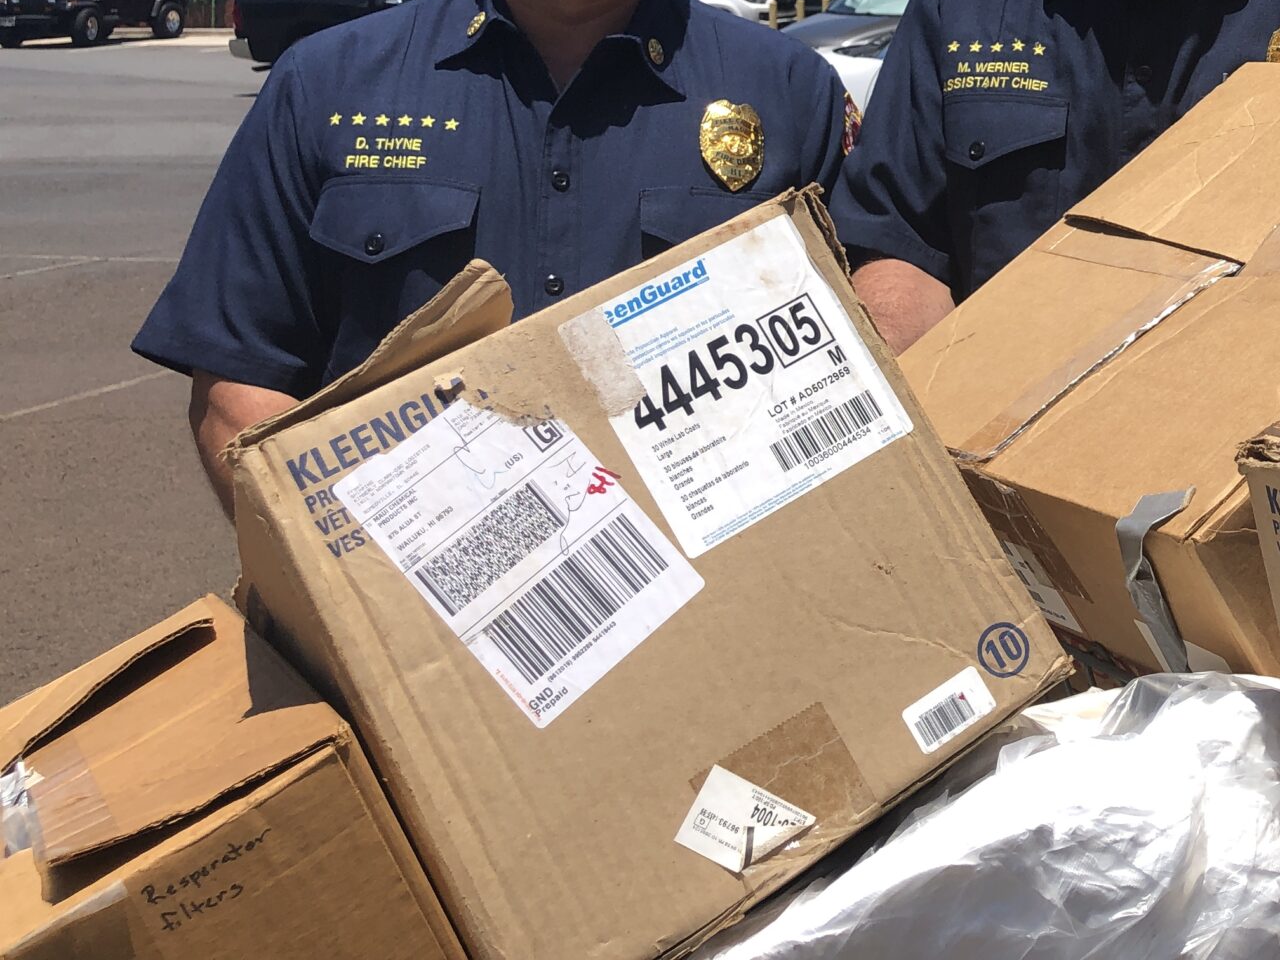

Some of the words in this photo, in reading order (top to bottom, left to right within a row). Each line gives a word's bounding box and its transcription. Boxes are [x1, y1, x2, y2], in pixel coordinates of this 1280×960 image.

[957, 62, 971, 73] M.
[975, 62, 1029, 74] WERNER
[1011, 77, 1049, 91] CHIEF
[355, 137, 369, 150] D.
[375, 137, 422, 151] THYNE
[345, 155, 380, 169] FIRE
[383, 156, 427, 169] CHIEF
[634, 323, 774, 431] 44453
[768, 302, 821, 357] 05
[827, 345, 848, 367] M
[766, 400, 789, 418] LOT
[788, 396, 798, 405] #
[529, 420, 560, 445] G
[650, 443, 660, 452] 30
[657, 435, 675, 449] White
[673, 429, 686, 440] Lab
[683, 421, 701, 434] Coats
[501, 451, 527, 469] (US)
[655, 447, 674, 463] Large
[663, 464, 672, 473] 30
[690, 449, 699, 458] de
[697, 433, 727, 454] laboratoire
[668, 464, 693, 482] blanches
[673, 475, 694, 491] Grande
[679, 493, 689, 503] 30
[686, 478, 716, 500] chaquetas
[713, 474, 722, 483] de
[720, 458, 750, 480] laboratorio
[371, 509, 392, 523] MAUI
[384, 488, 420, 510] CHEMICAL
[374, 504, 411, 527] PRODUCTS
[405, 495, 419, 505] INC
[685, 494, 708, 512] blancas
[690, 502, 715, 520] Grandes
[427, 519, 437, 527] HI
[985, 630, 1022, 668] 10
[527, 685, 555, 711] GND
[534, 685, 570, 718] Prepaid
